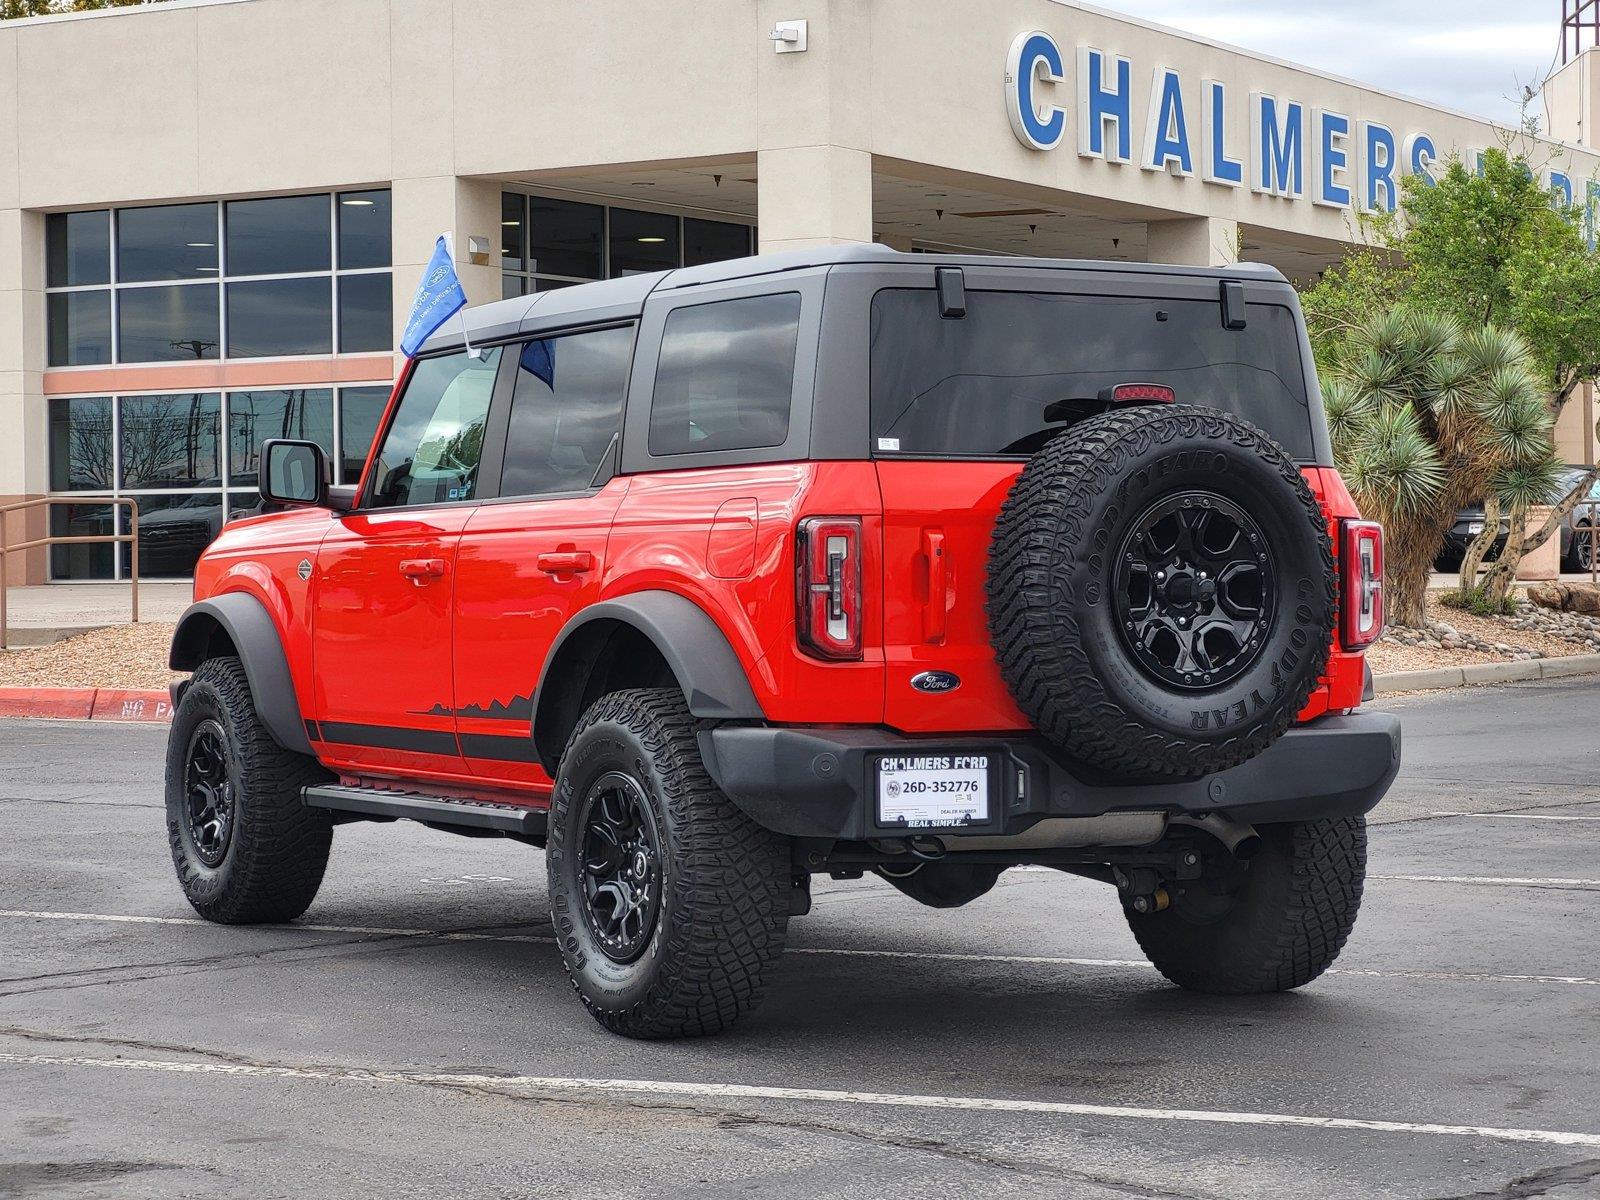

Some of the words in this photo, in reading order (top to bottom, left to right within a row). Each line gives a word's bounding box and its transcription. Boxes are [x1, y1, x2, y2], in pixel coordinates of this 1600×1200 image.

[1005, 30, 1439, 222] CHALMERS
[923, 675, 950, 688] Ford
[903, 780, 978, 793] 26D-352776
[908, 820, 930, 828] REAL
